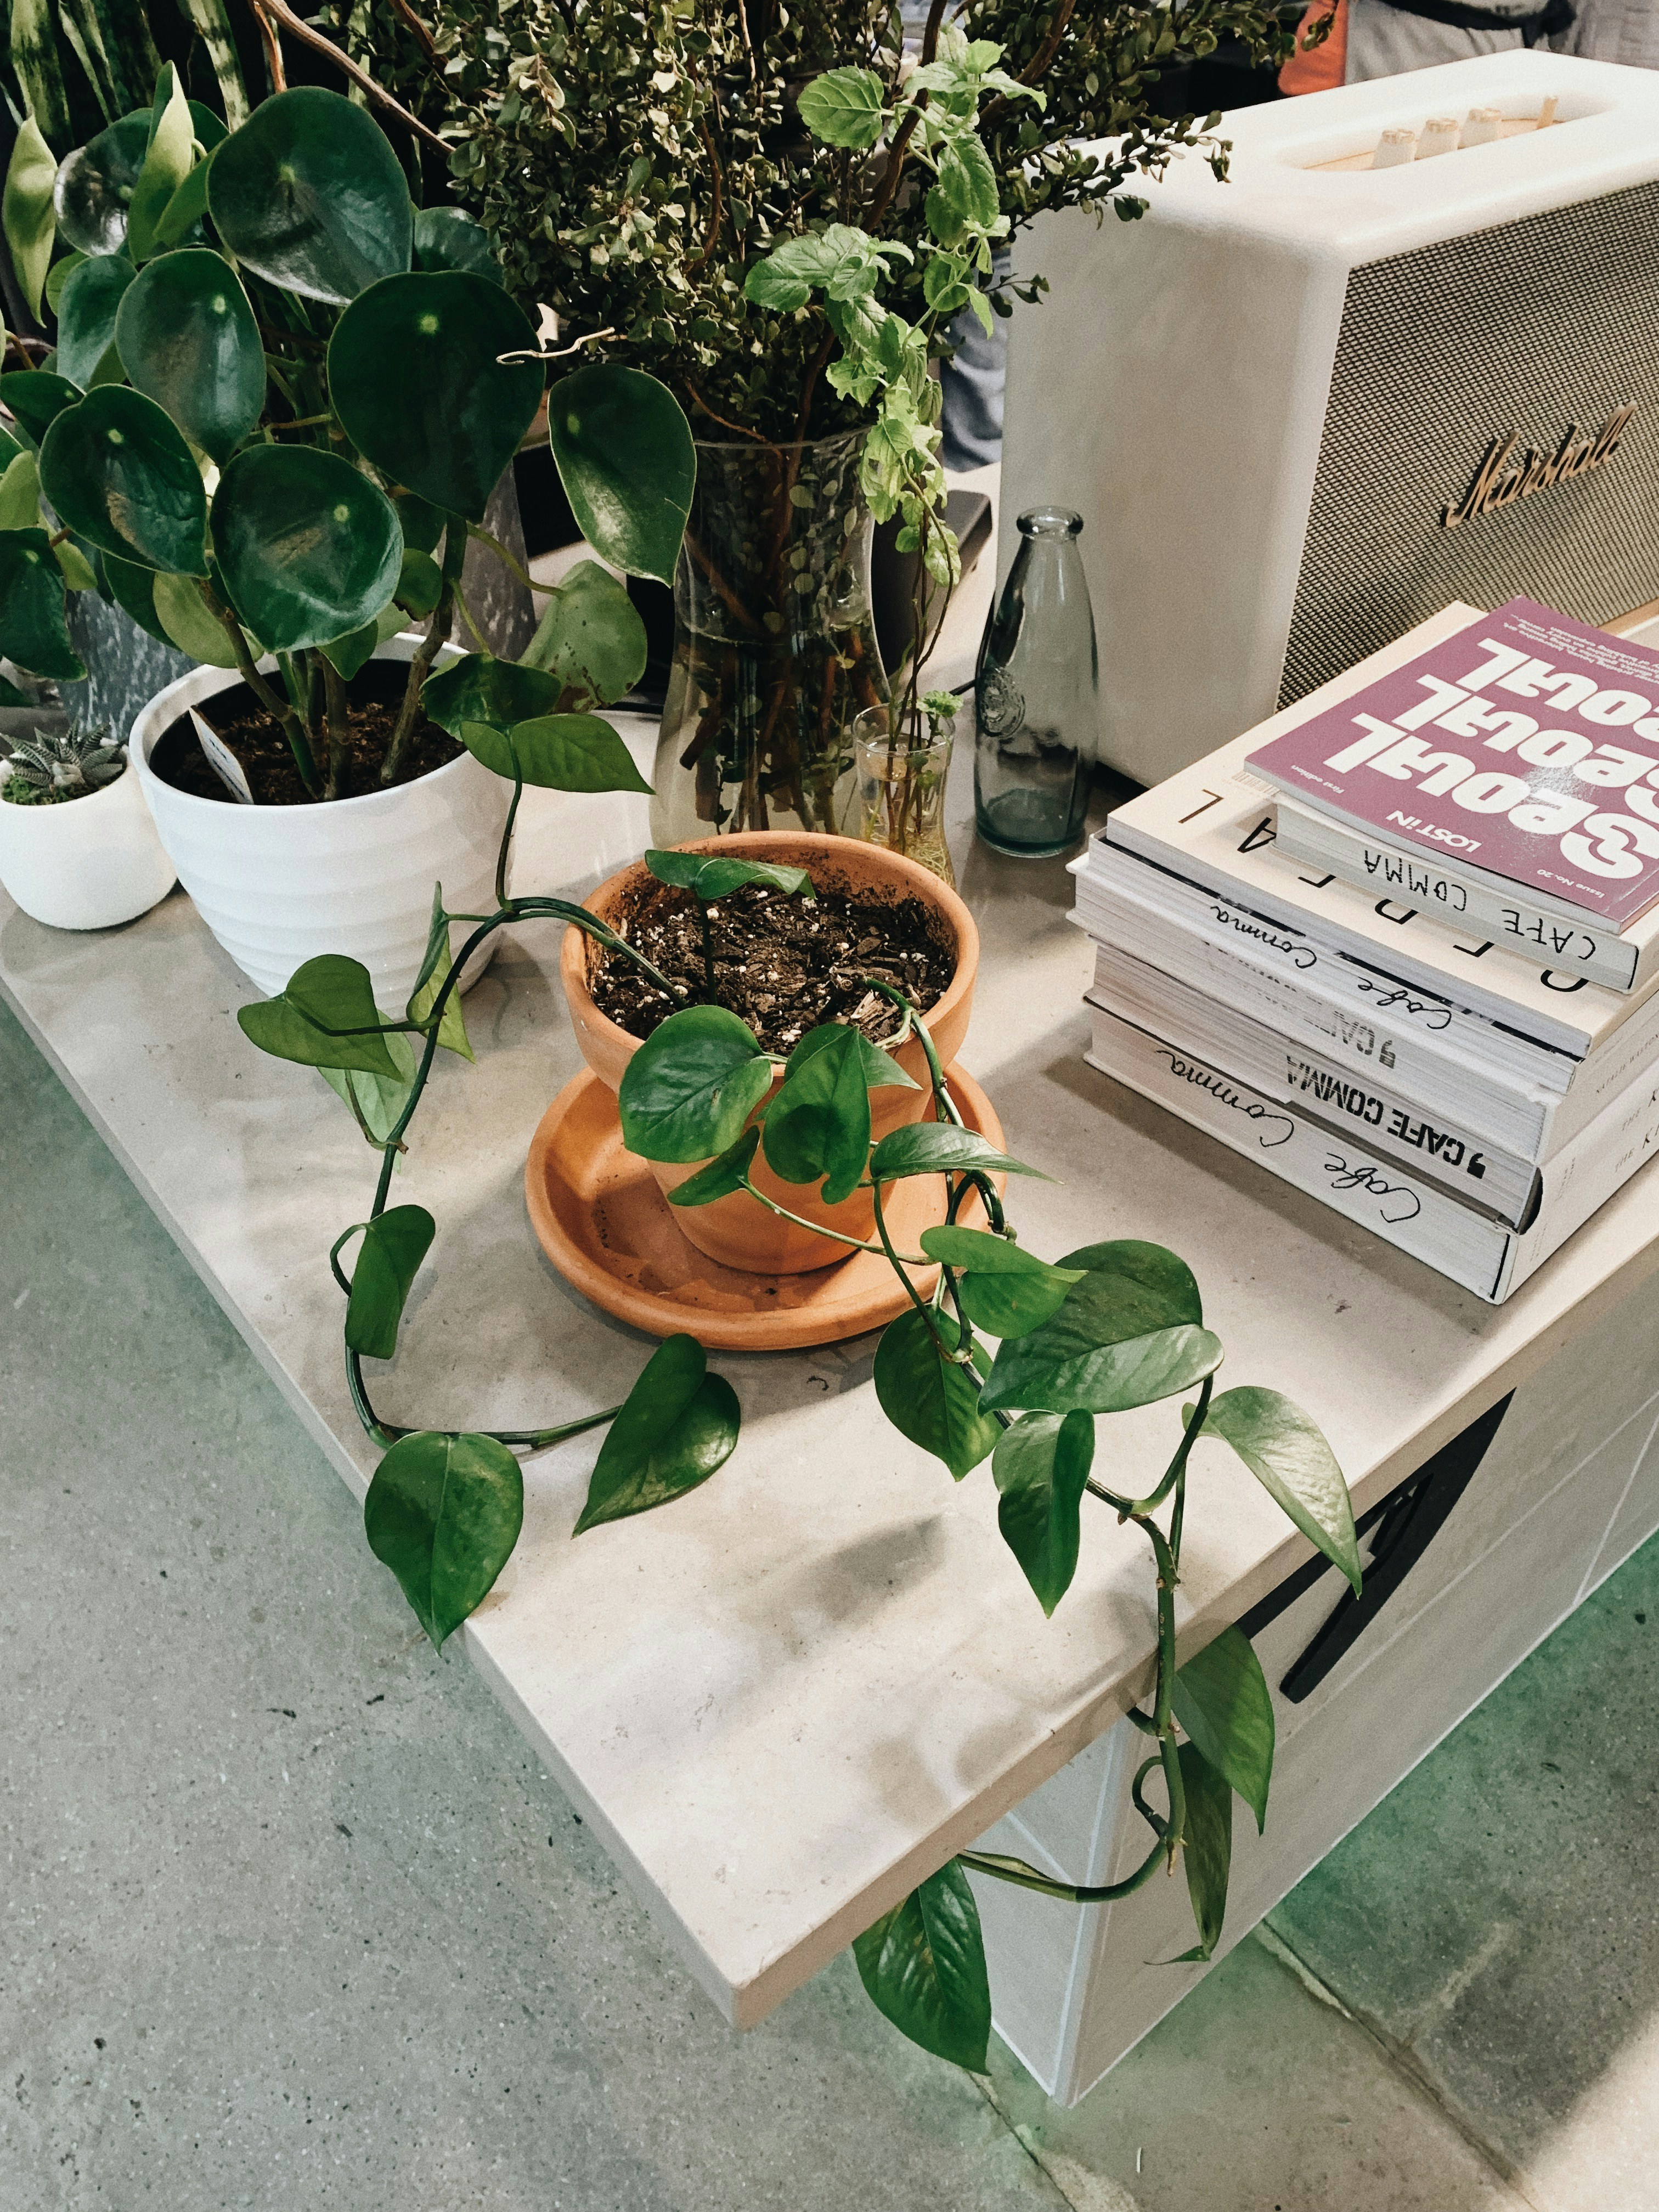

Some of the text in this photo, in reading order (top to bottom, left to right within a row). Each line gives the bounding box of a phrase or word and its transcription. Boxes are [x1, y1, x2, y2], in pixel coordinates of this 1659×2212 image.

[1441, 401, 1639, 527] Marshall
[1517, 623, 1548, 638] among
[1291, 764, 1345, 794] First edition
[1415, 824, 1483, 853] LOST
[1364, 850, 1596, 960] CAFE COMMA
[1575, 883, 1605, 899] Issue
[1357, 976, 1453, 1030] Cafe
[1286, 1056, 1466, 1166] CAFE COMMA
[1324, 1152, 1421, 1223] Cafe
